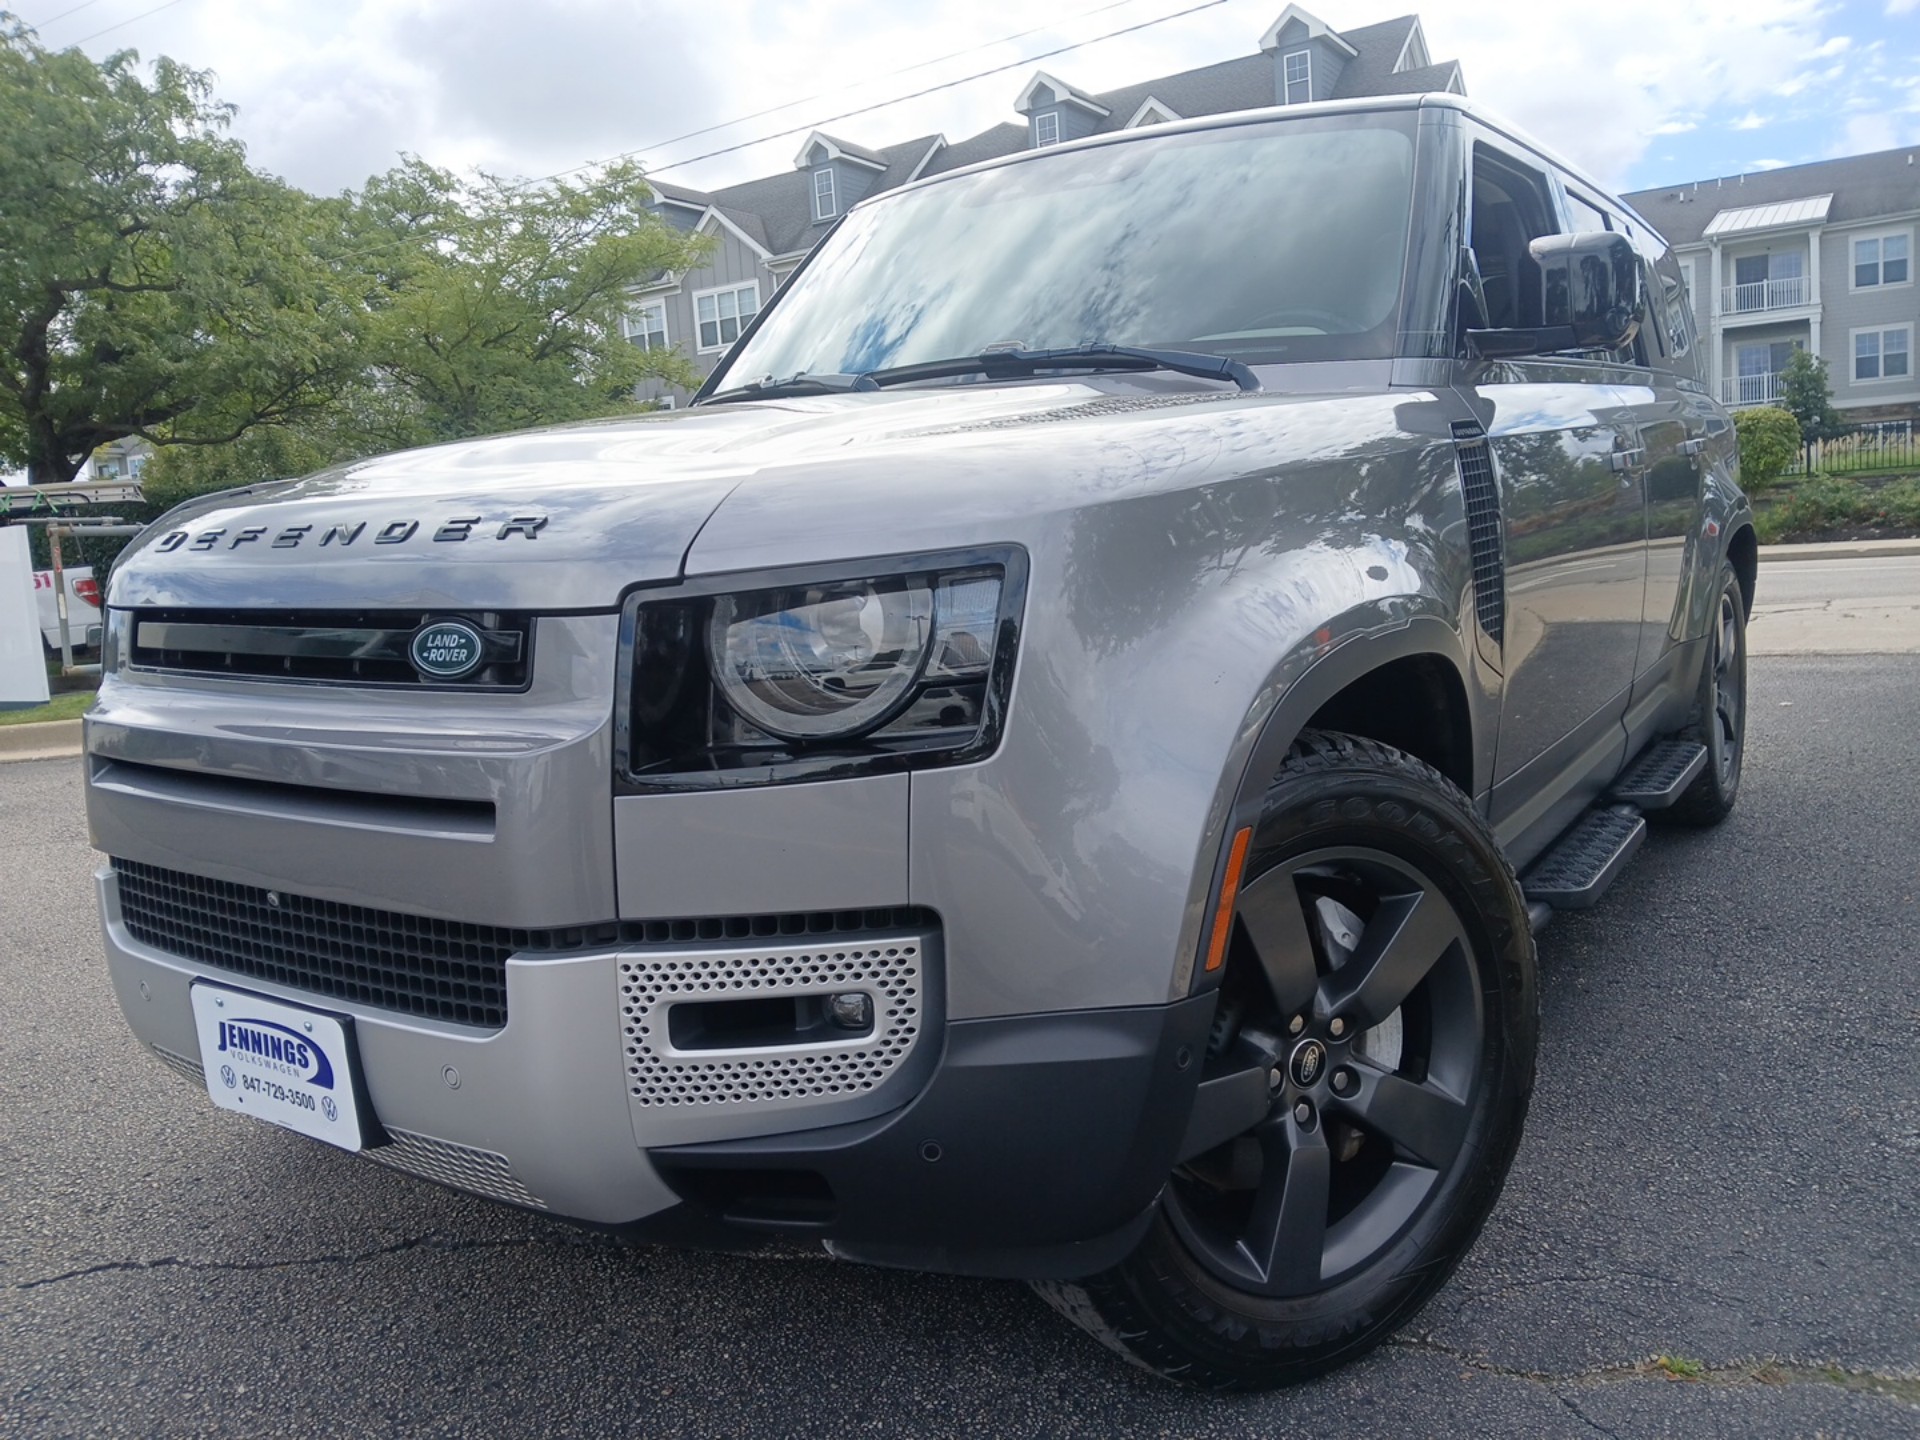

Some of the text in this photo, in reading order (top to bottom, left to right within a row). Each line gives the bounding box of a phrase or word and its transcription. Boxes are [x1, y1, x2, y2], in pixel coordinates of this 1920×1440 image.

[154, 515, 549, 552] DEFENDER
[427, 634, 459, 647] LAND
[429, 649, 468, 661] ROVER
[218, 1021, 310, 1069] JENNINGS
[231, 1049, 300, 1078] VOLKSWAGEN
[242, 1074, 316, 1111] 847-729-3500
